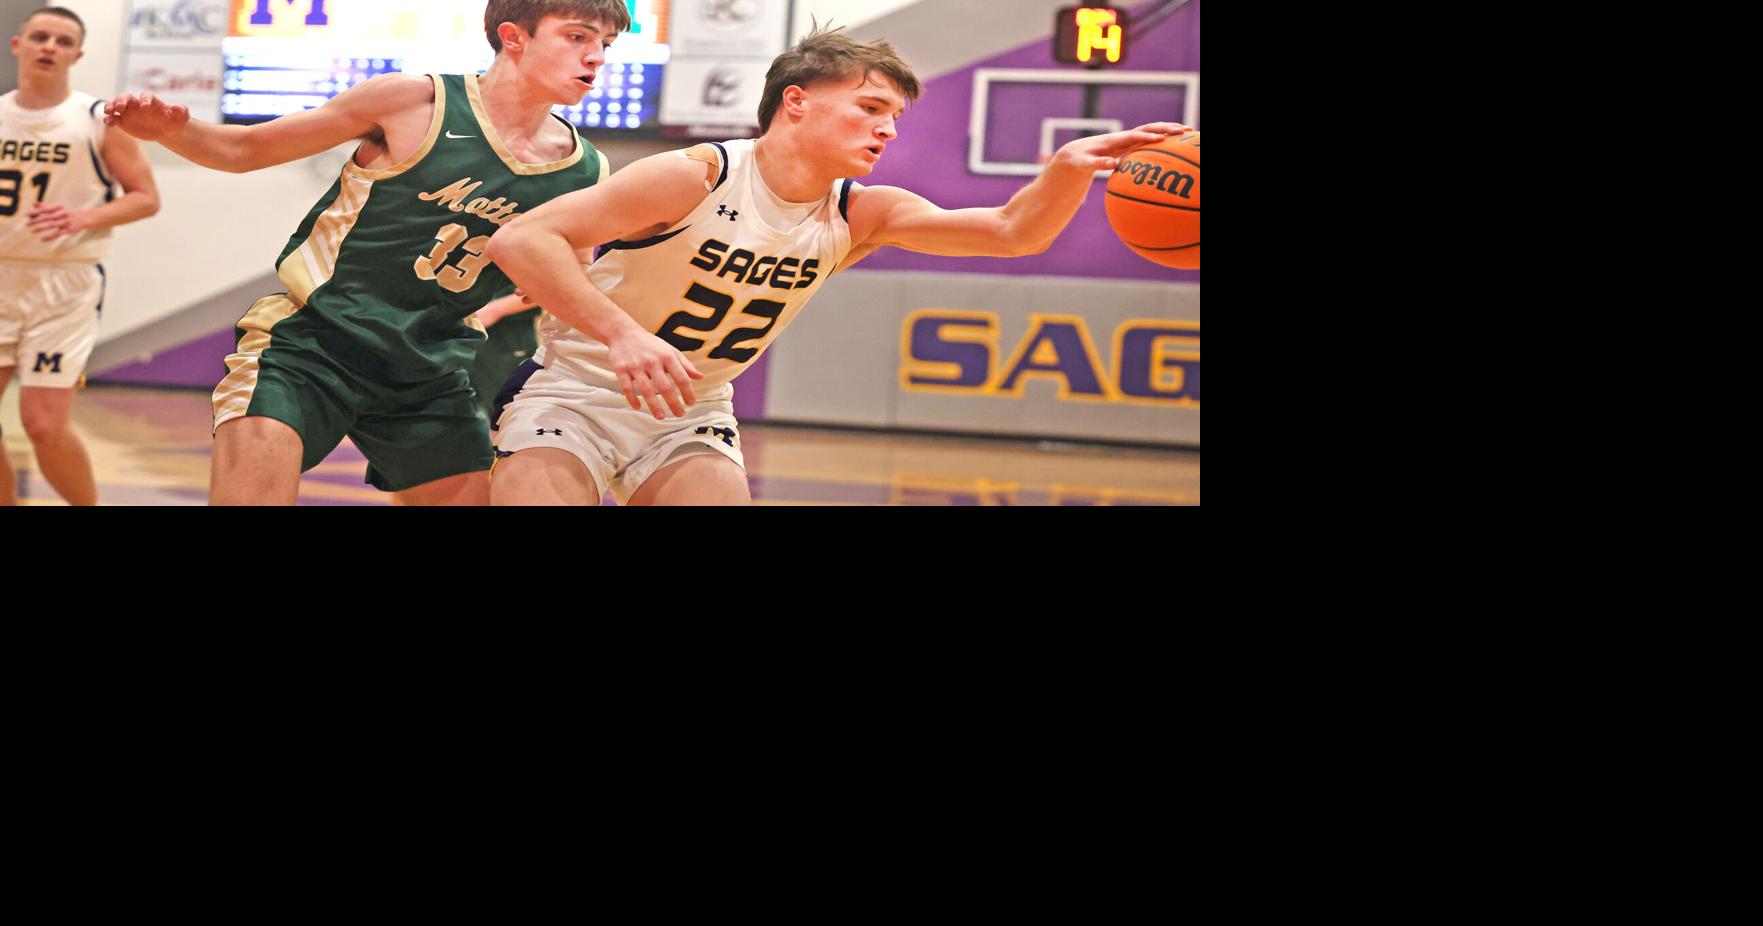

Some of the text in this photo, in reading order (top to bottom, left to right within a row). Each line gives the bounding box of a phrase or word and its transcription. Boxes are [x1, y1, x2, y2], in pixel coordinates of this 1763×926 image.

[0, 140, 71, 163] AGES
[413, 222, 494, 293] 33
[689, 238, 820, 290] SAGES
[654, 281, 787, 364] 22
[31, 350, 64, 374] M
